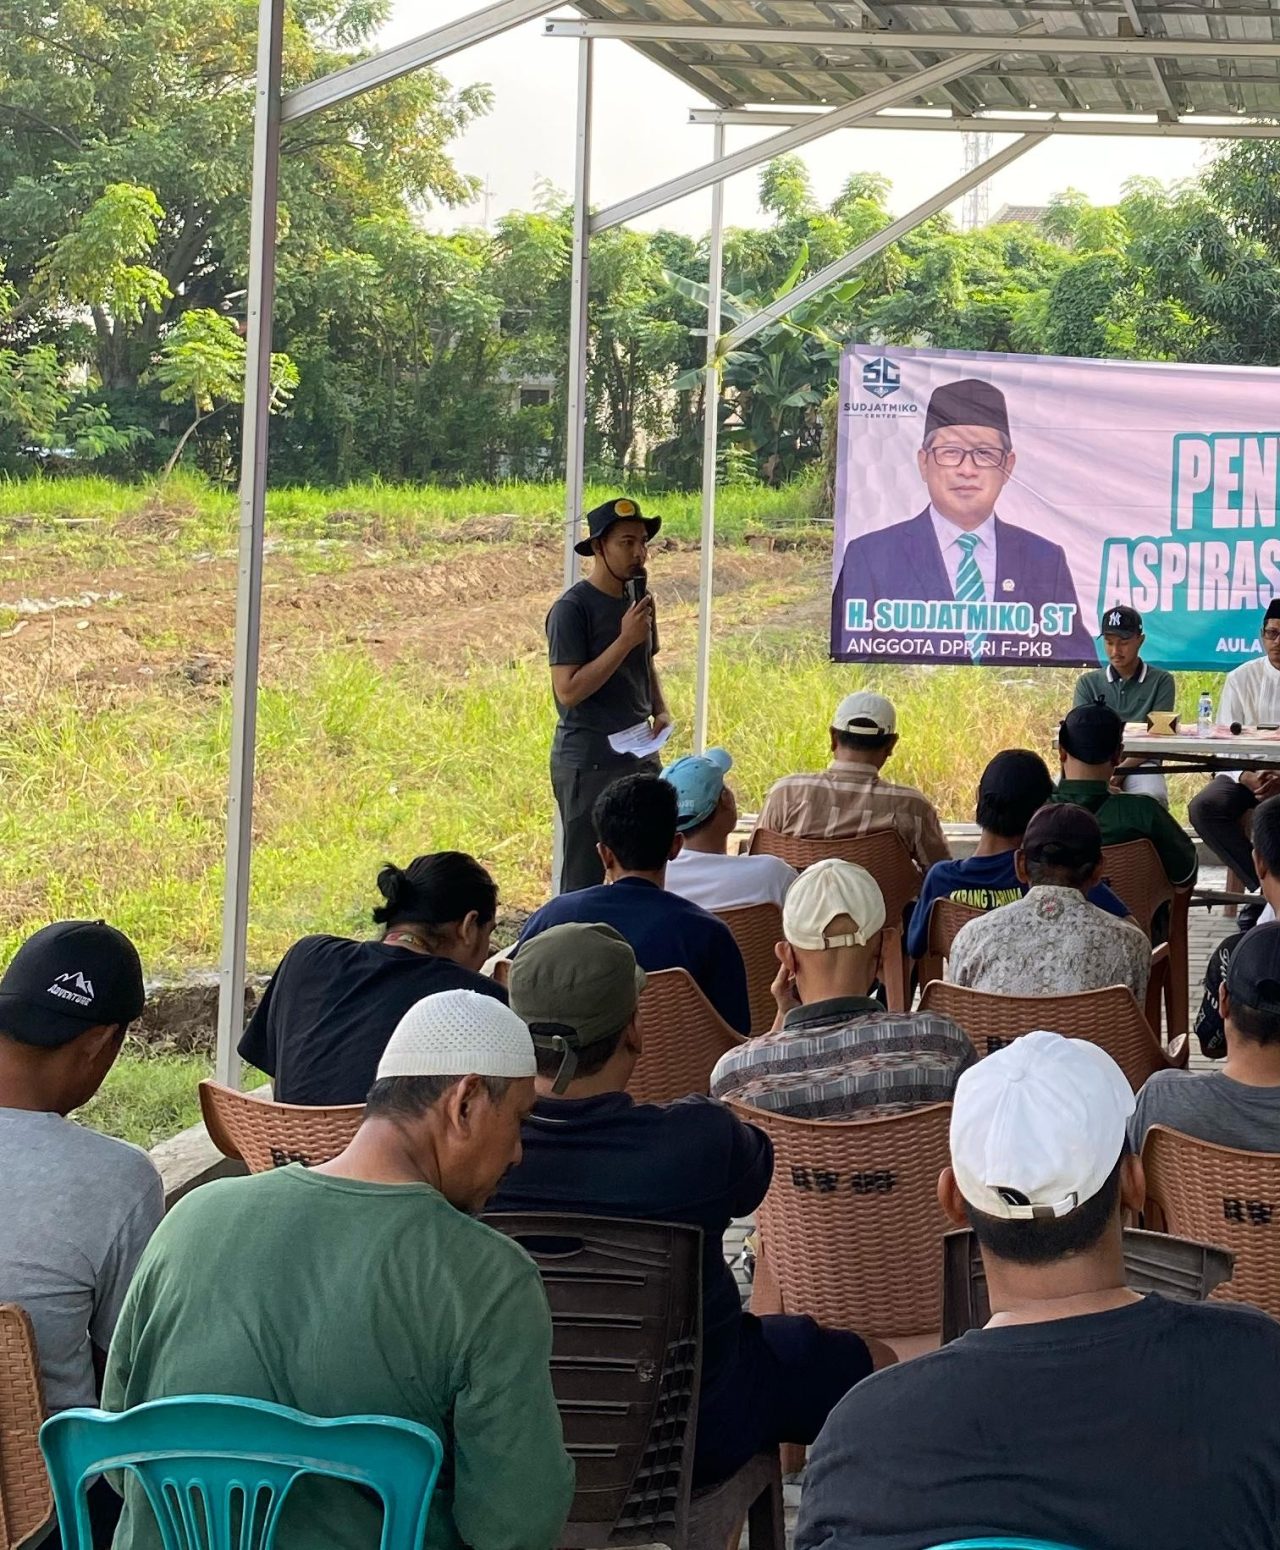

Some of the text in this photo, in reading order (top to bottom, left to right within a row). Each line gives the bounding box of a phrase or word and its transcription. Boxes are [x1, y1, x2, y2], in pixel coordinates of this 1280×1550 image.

[844, 402, 918, 413] SUDJATMIKO
[847, 600, 1076, 637] H. SUDJATMIKO, ST
[847, 638, 1052, 657] ANGGOTA DPR RI F-PKB
[1215, 638, 1262, 653] AULA
[47, 983, 92, 1006] ADVENTURE
